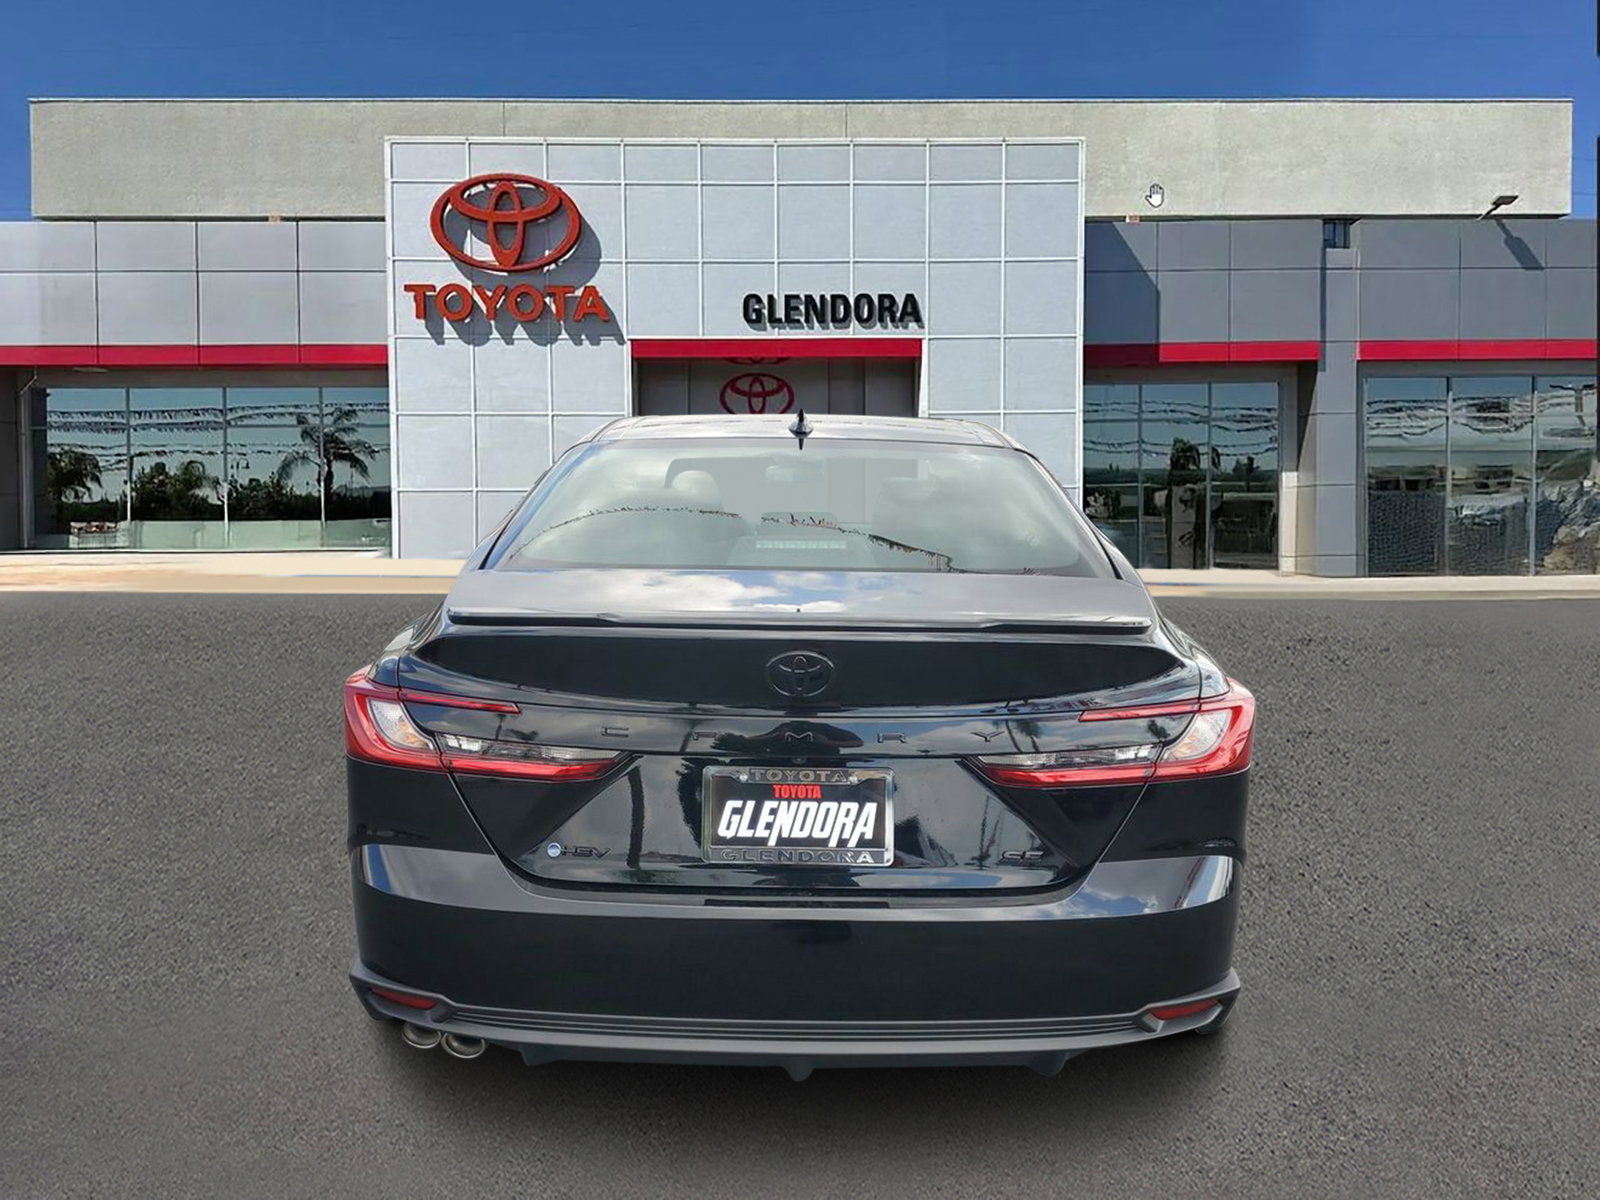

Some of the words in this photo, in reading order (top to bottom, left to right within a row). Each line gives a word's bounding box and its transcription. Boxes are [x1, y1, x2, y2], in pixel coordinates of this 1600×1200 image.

[403, 283, 610, 322] TOYOTA
[743, 293, 922, 325] GLENDORA
[751, 769, 847, 783] TOYOTA
[773, 784, 822, 799] TOYOTA
[718, 800, 878, 847] GLENDORA
[562, 846, 611, 858] HEV
[721, 851, 875, 863] GLENDORA
